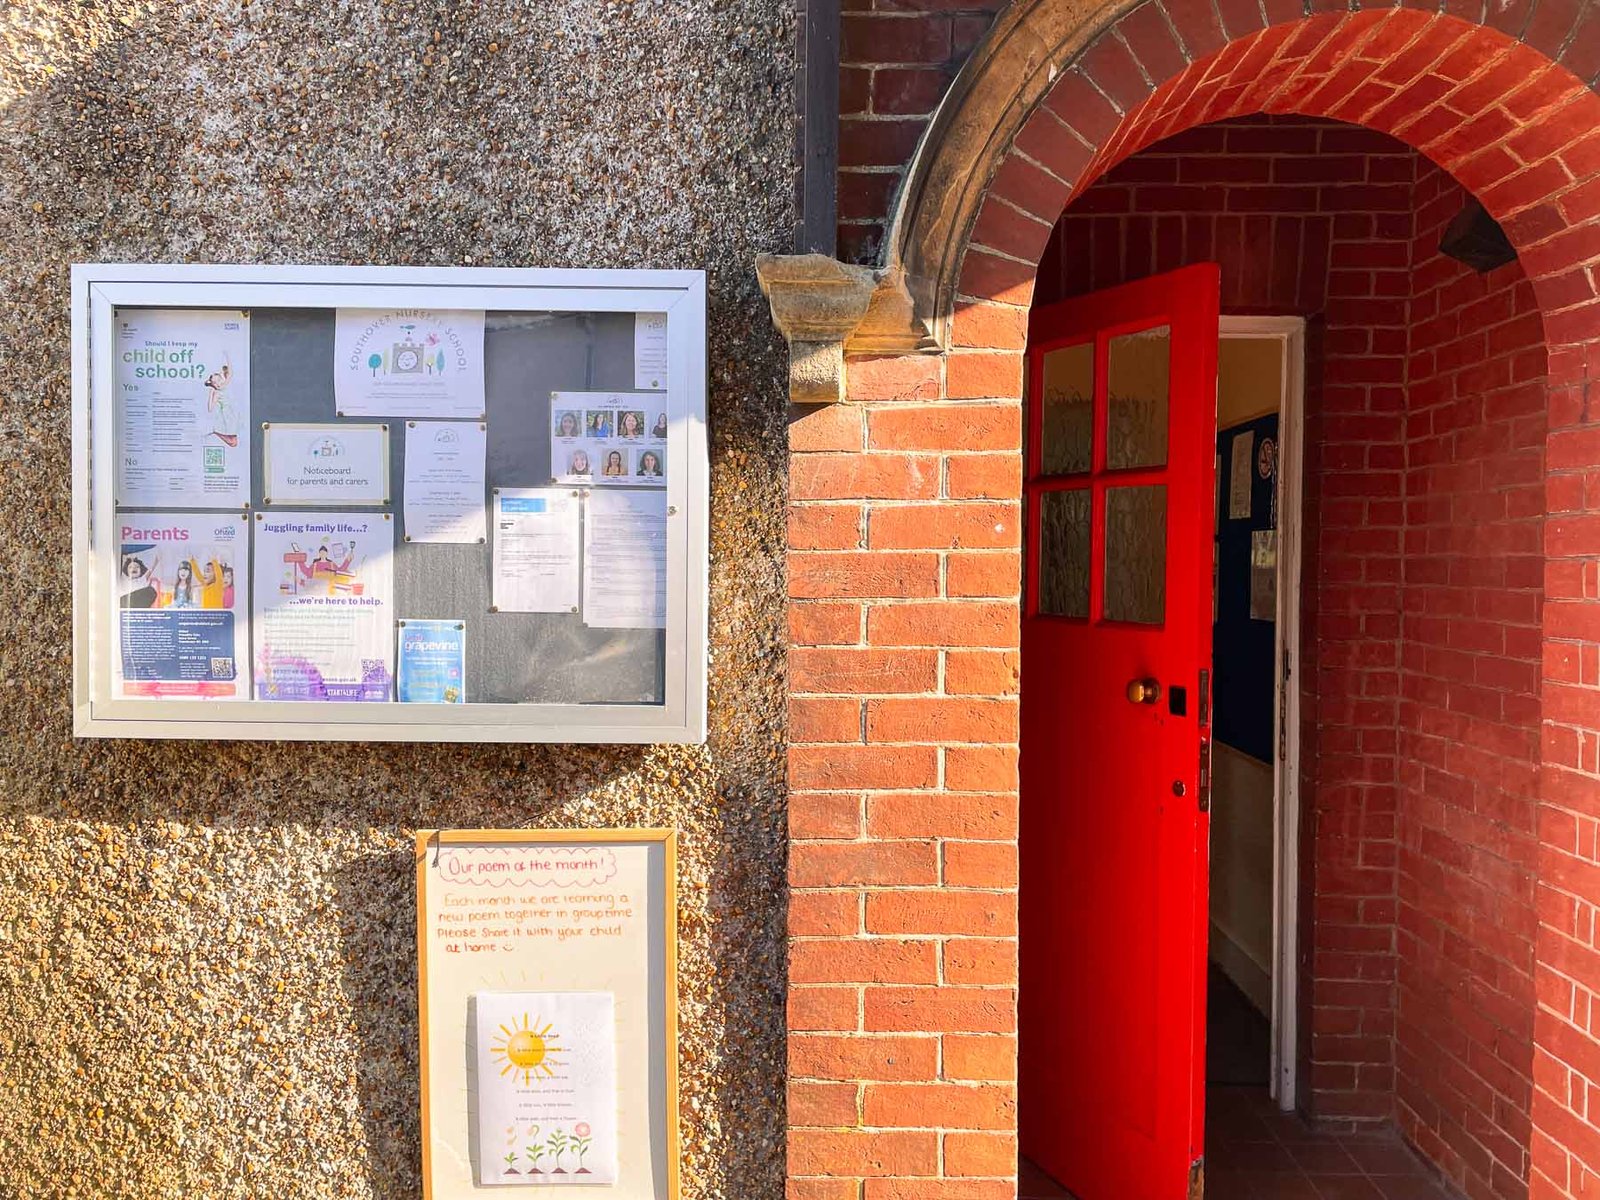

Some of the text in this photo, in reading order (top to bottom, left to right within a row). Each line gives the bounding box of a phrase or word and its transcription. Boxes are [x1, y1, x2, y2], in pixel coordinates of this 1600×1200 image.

[172, 340, 187, 348] keep
[122, 348, 194, 363] child off
[135, 364, 205, 379] school?
[122, 384, 139, 392] Yes
[125, 458, 138, 466] No
[303, 466, 352, 475] Noticeboard
[287, 477, 298, 485] for
[300, 479, 328, 488] parents
[329, 477, 344, 486] and
[121, 526, 189, 540] Parents
[264, 524, 304, 533] Juggling
[306, 524, 336, 533] family
[360, 598, 384, 608] help.
[405, 640, 459, 652] grapevine
[448, 856, 474, 875] Our
[478, 862, 511, 874] poem
[528, 860, 551, 871] the
[444, 892, 629, 909] Each month we are learning a
[438, 912, 464, 923] new
[468, 910, 501, 923] poem
[504, 908, 552, 924] together
[556, 909, 568, 918] in
[513, 927, 520, 936] it
[526, 927, 553, 937] with
[558, 927, 584, 941] your
[590, 924, 622, 937] child
[446, 941, 498, 954] at home
